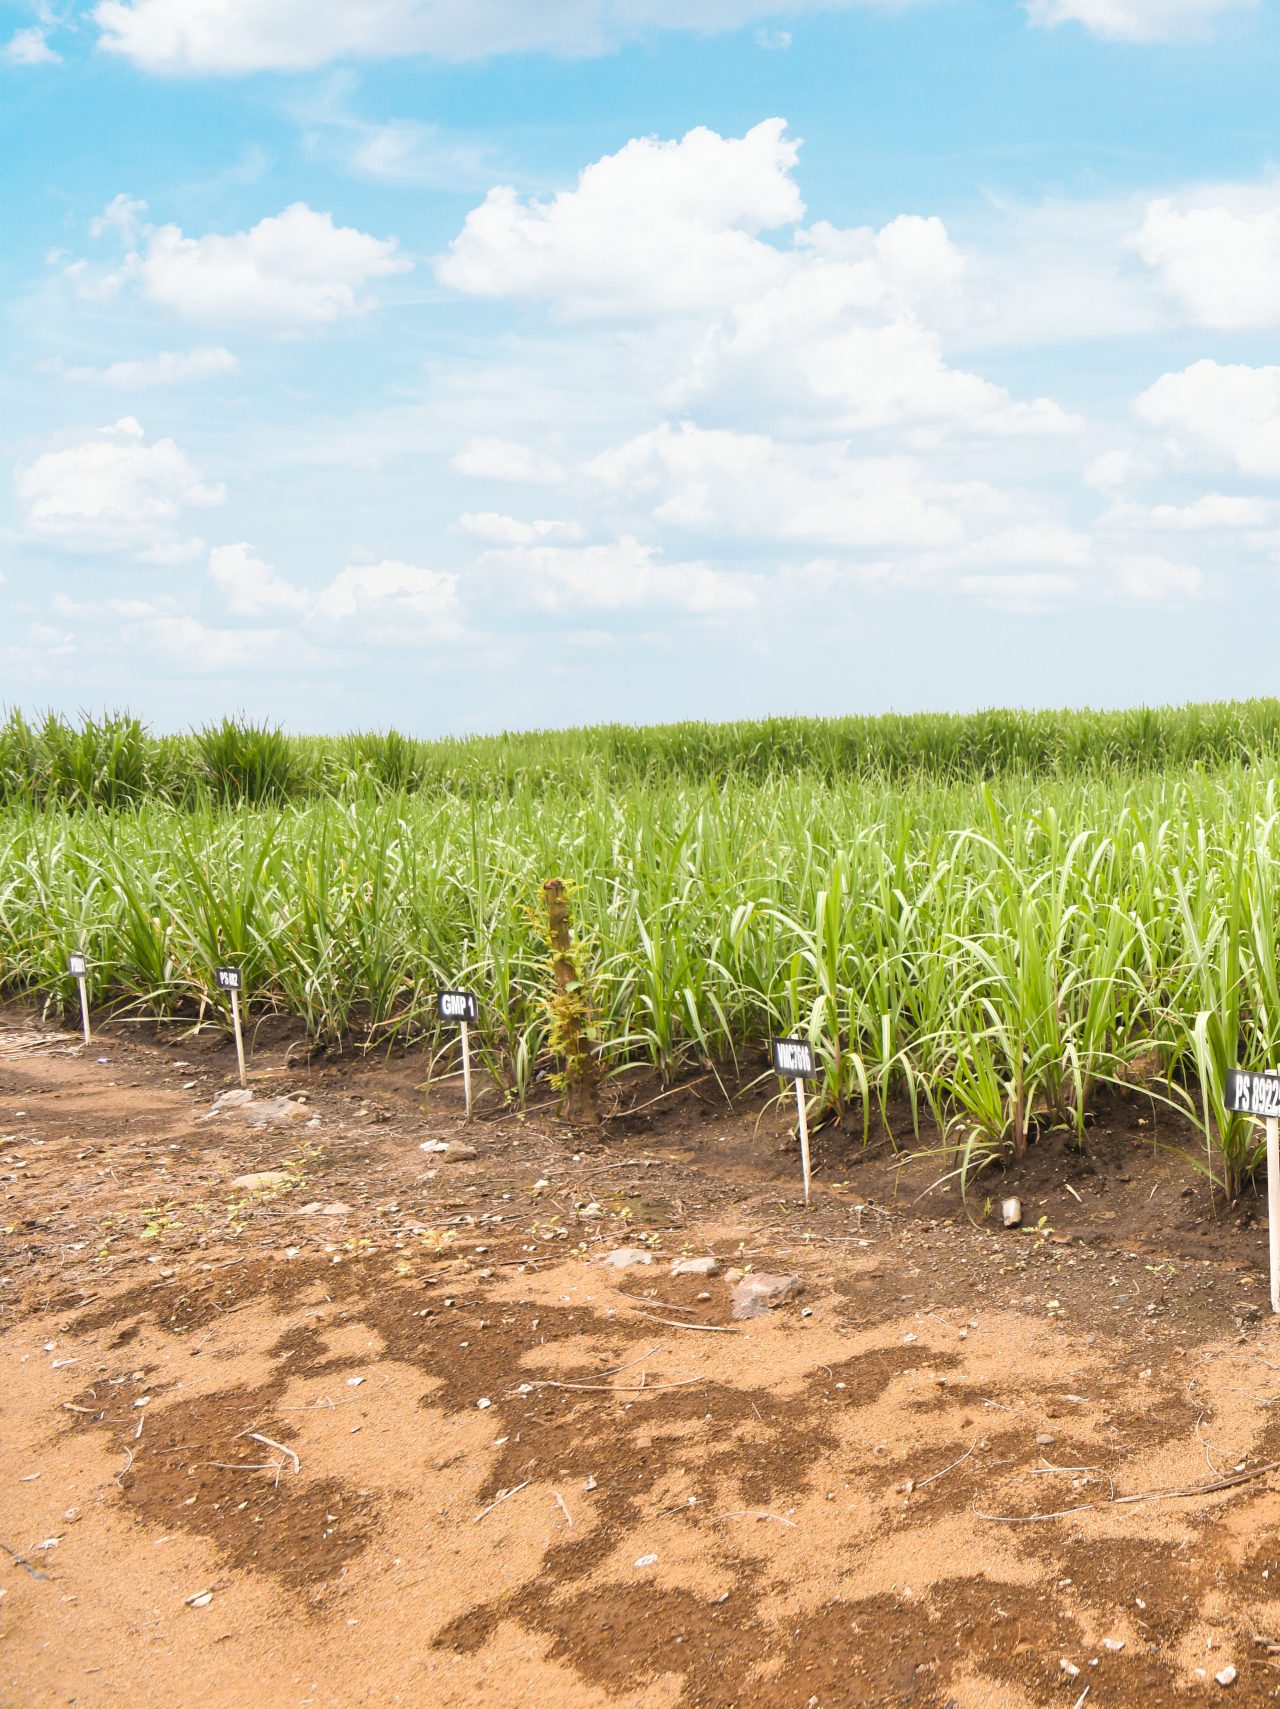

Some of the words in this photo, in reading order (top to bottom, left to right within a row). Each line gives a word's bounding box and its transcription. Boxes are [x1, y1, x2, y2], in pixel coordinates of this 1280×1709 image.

[441, 994, 467, 1015] GMP
[468, 996, 475, 1017] 1
[1235, 1074, 1251, 1110] PS
